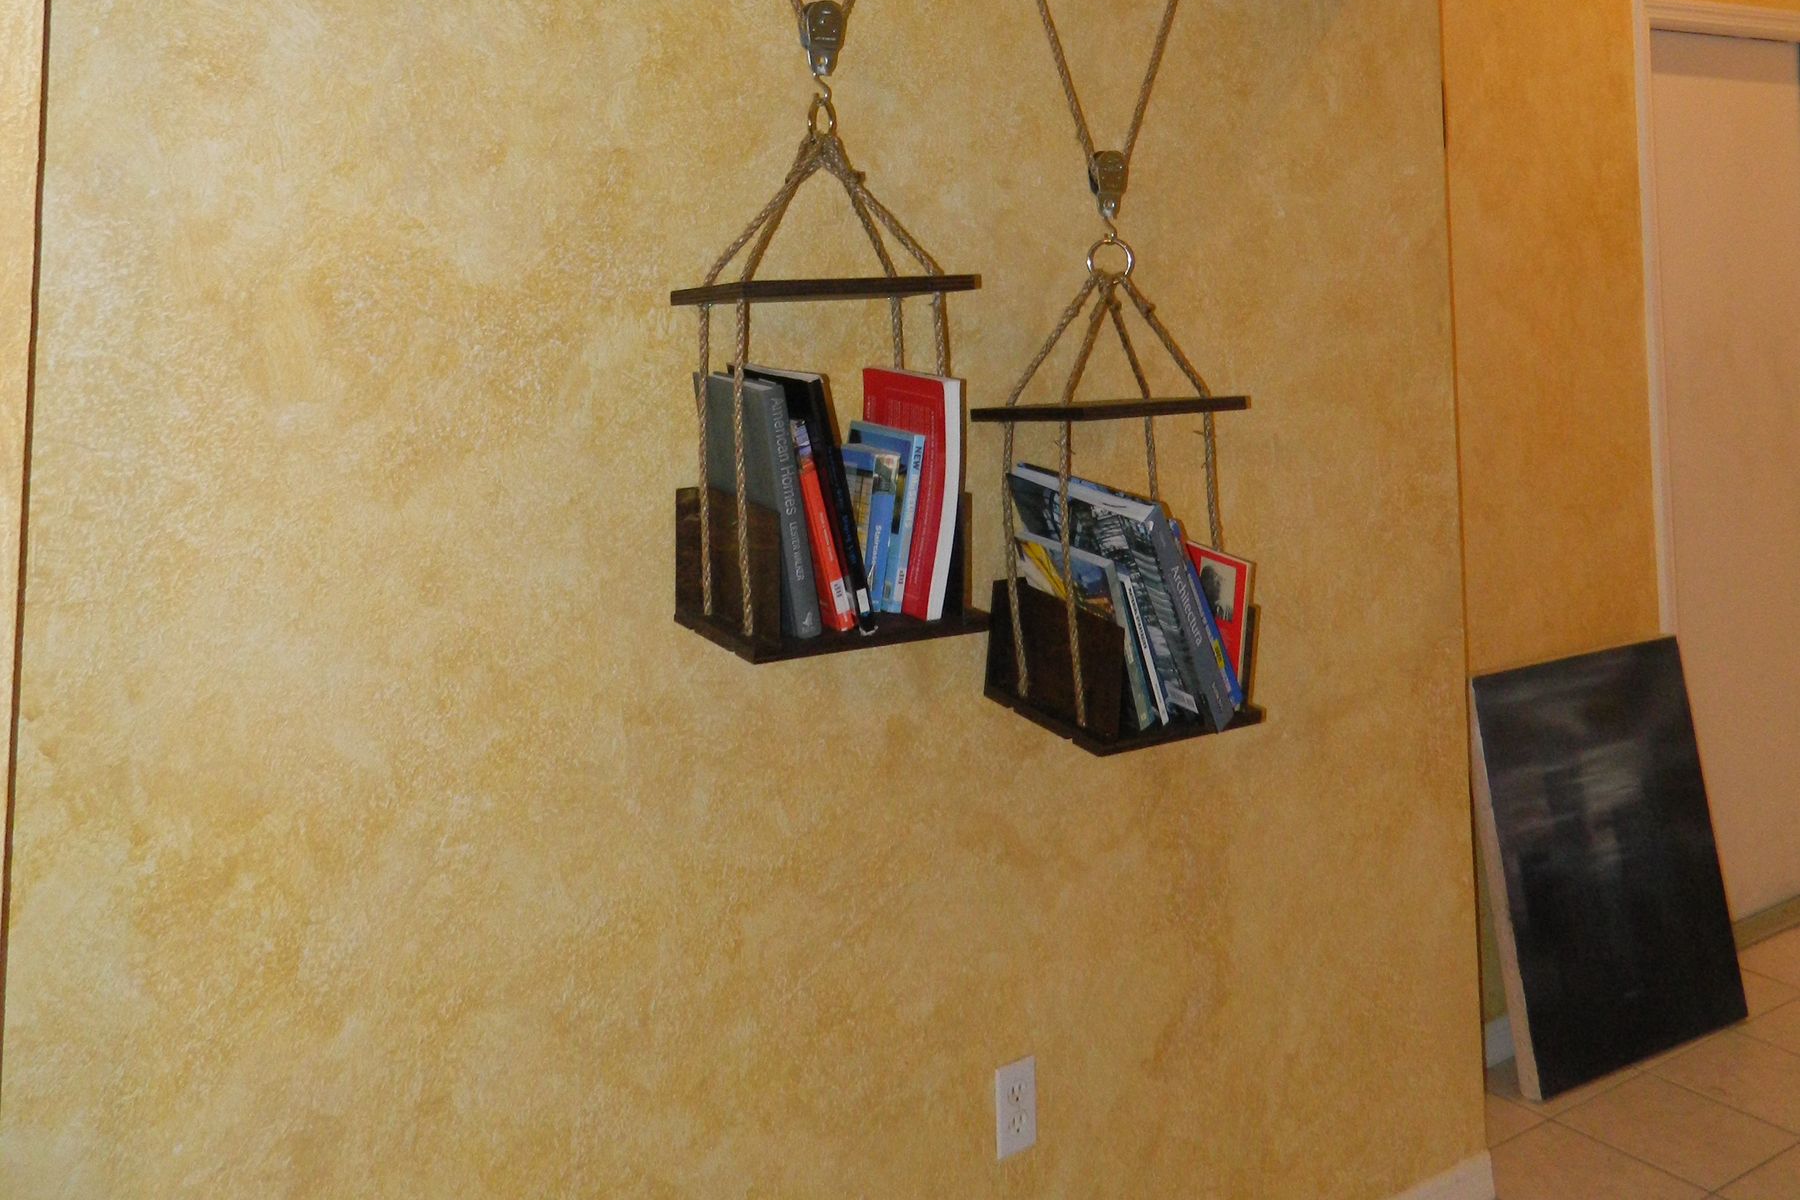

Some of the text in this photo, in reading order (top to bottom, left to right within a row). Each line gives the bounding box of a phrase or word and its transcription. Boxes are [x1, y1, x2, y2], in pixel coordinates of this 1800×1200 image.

[771, 397, 790, 462] American
[912, 445, 923, 471] NEW
[780, 463, 797, 516] Homes
[1171, 565, 1203, 647] Architectura
